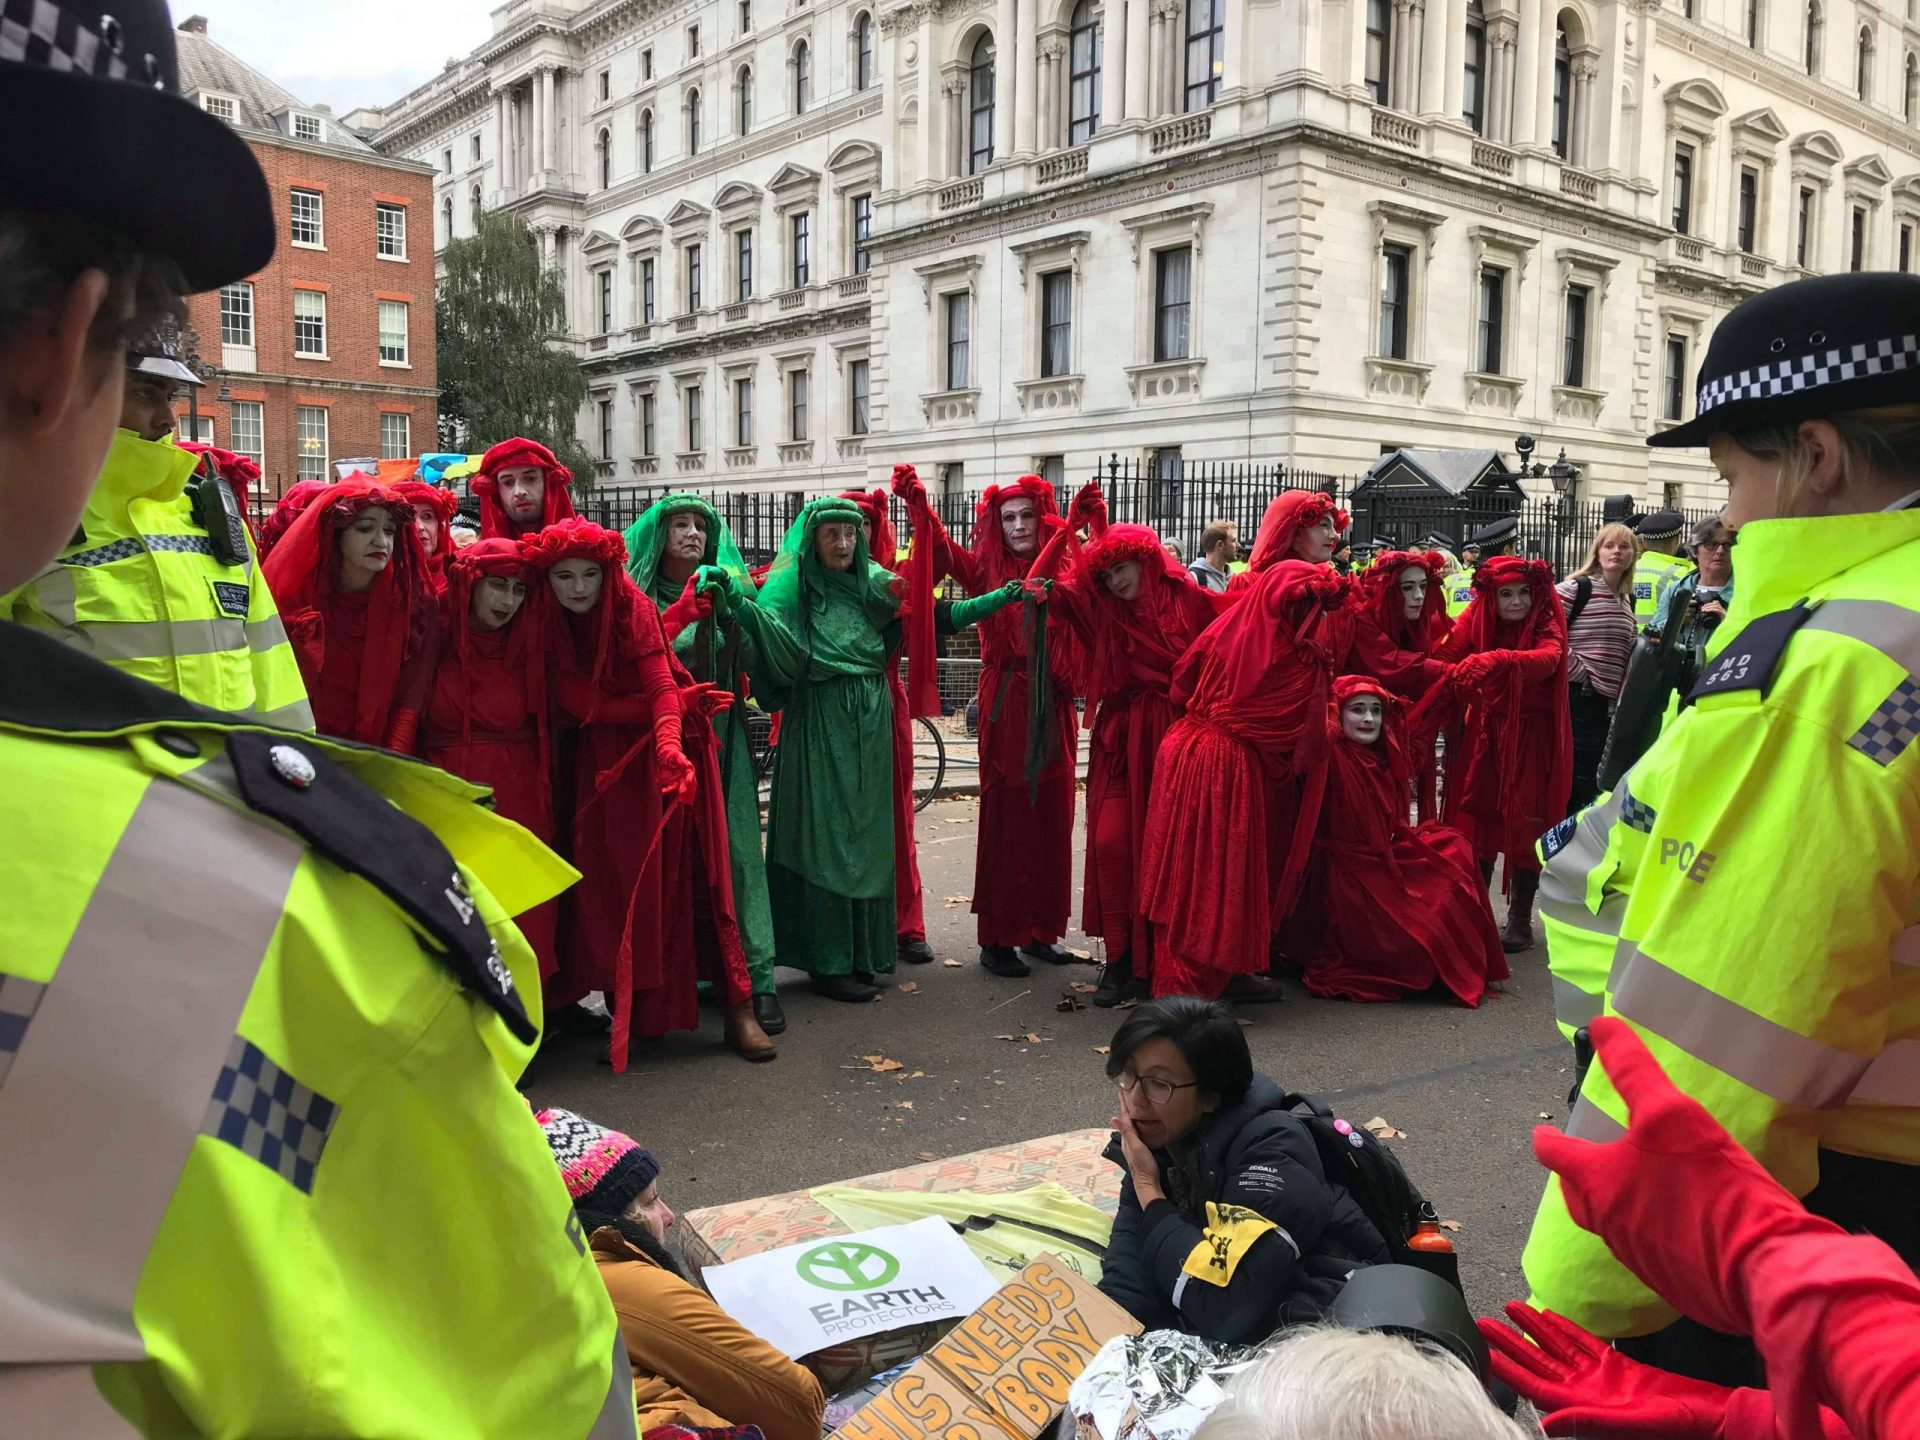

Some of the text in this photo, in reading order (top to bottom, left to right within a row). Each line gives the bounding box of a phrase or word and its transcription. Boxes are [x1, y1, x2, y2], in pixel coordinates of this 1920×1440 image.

[1706, 667, 1749, 686] 563
[809, 1285, 946, 1325] EARTH
[822, 1301, 957, 1337] PROTECTORS
[826, 1262, 1075, 1440] HIS NEEDS
